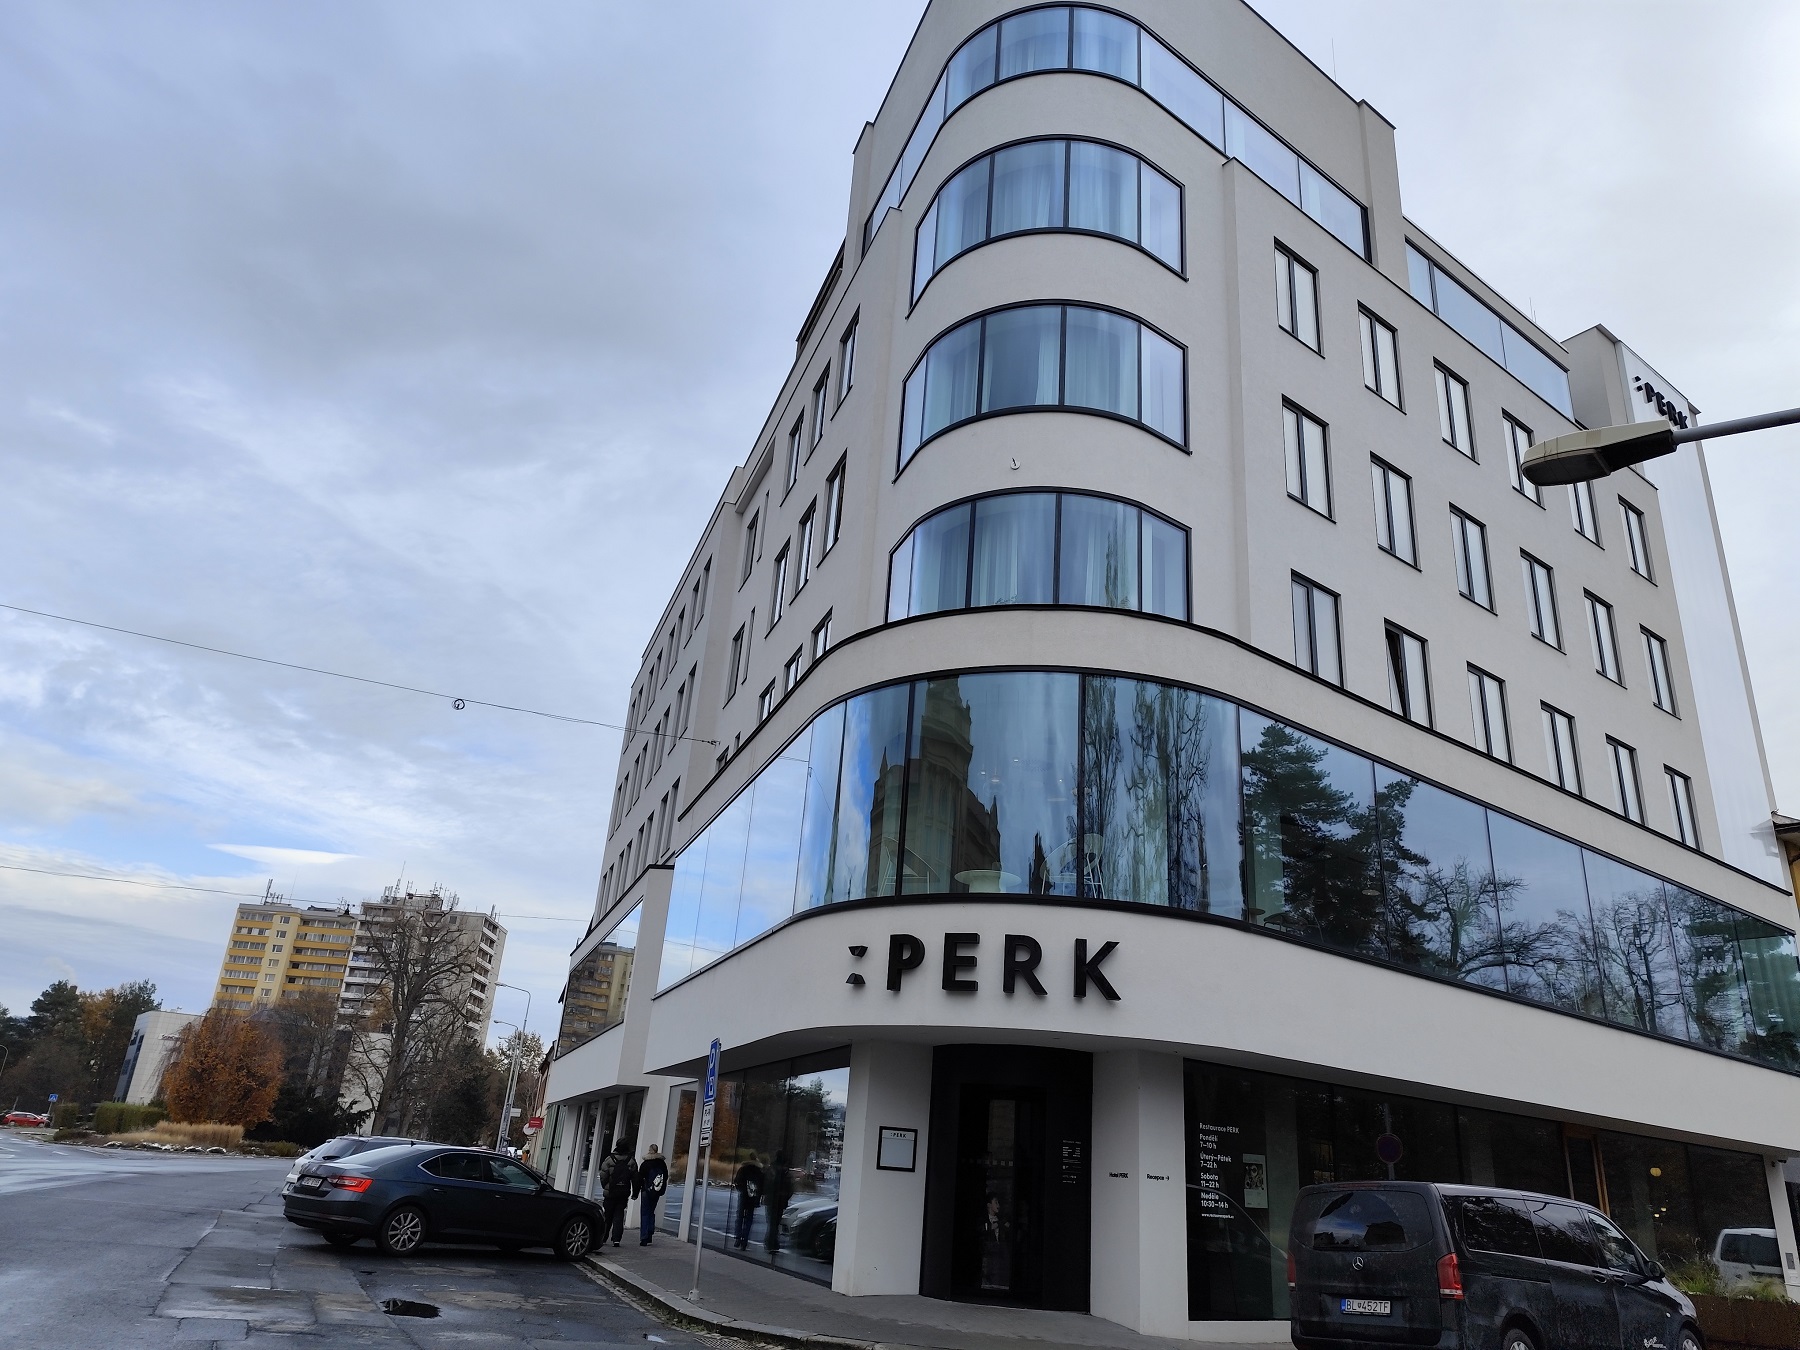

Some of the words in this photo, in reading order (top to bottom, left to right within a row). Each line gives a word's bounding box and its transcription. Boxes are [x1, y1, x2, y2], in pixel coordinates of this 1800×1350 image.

[1199, 1122, 1226, 1133] Restaurace
[1227, 1126, 1240, 1134] PERK
[1200, 1172, 1219, 1181] Sobota
